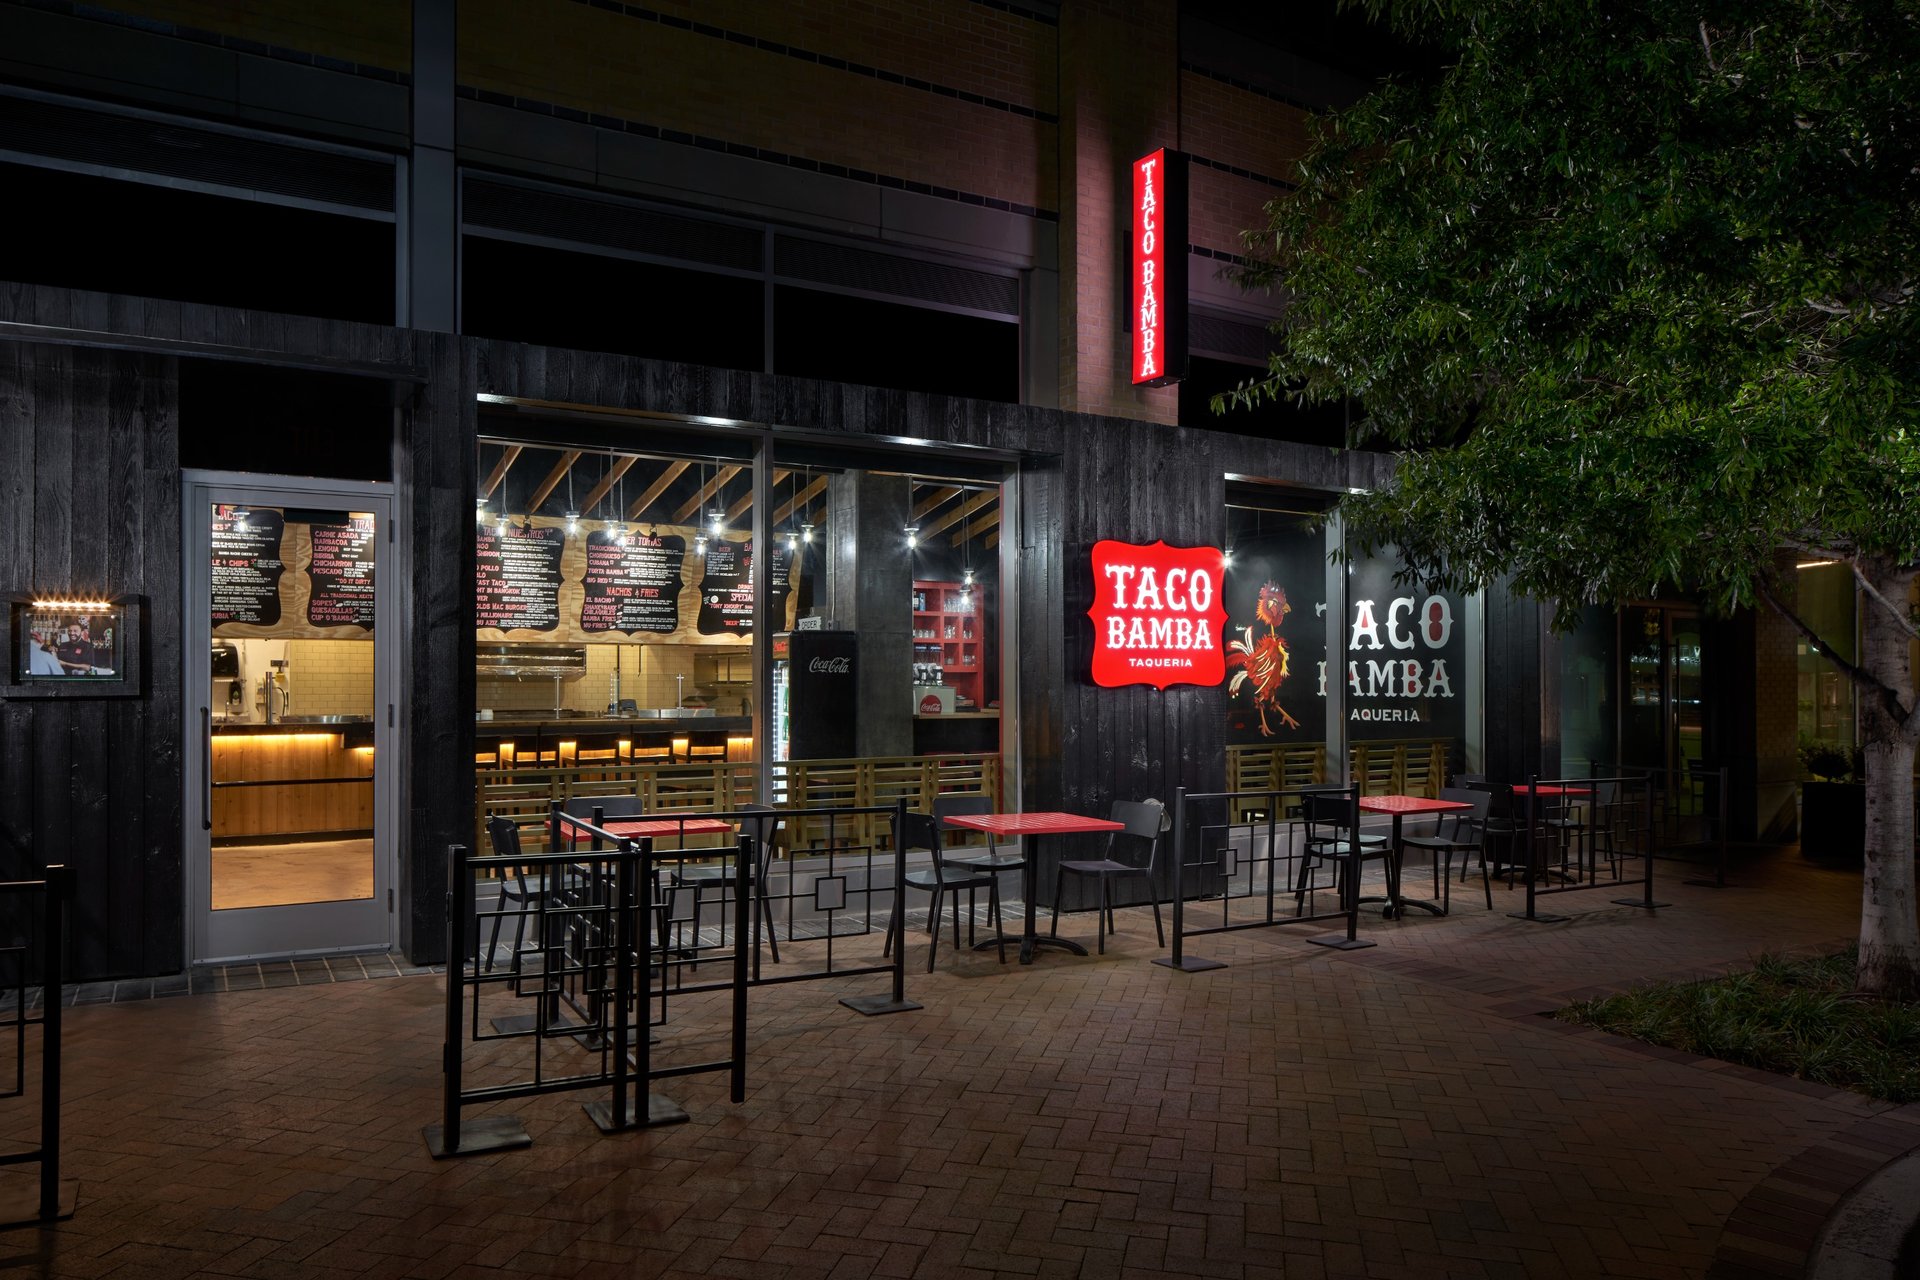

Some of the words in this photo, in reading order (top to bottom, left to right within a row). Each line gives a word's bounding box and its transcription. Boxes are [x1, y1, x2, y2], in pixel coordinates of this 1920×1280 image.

[1140, 158, 1156, 255] TACO
[1141, 259, 1156, 377] BAMBA
[314, 537, 348, 546] BARBACOA
[313, 567, 343, 575] PESCADO
[481, 565, 500, 573] POLLO
[491, 579, 506, 587] TACO
[1104, 563, 1213, 612] TACO
[606, 587, 632, 597] NACHOS
[640, 589, 659, 597] FRIES
[1315, 595, 1454, 651] ACO
[1106, 616, 1214, 650] BAMBA
[809, 656, 851, 673] Coca-Cola
[1128, 658, 1193, 667] TAQUERIA
[1350, 708, 1420, 722] AQUERIA
